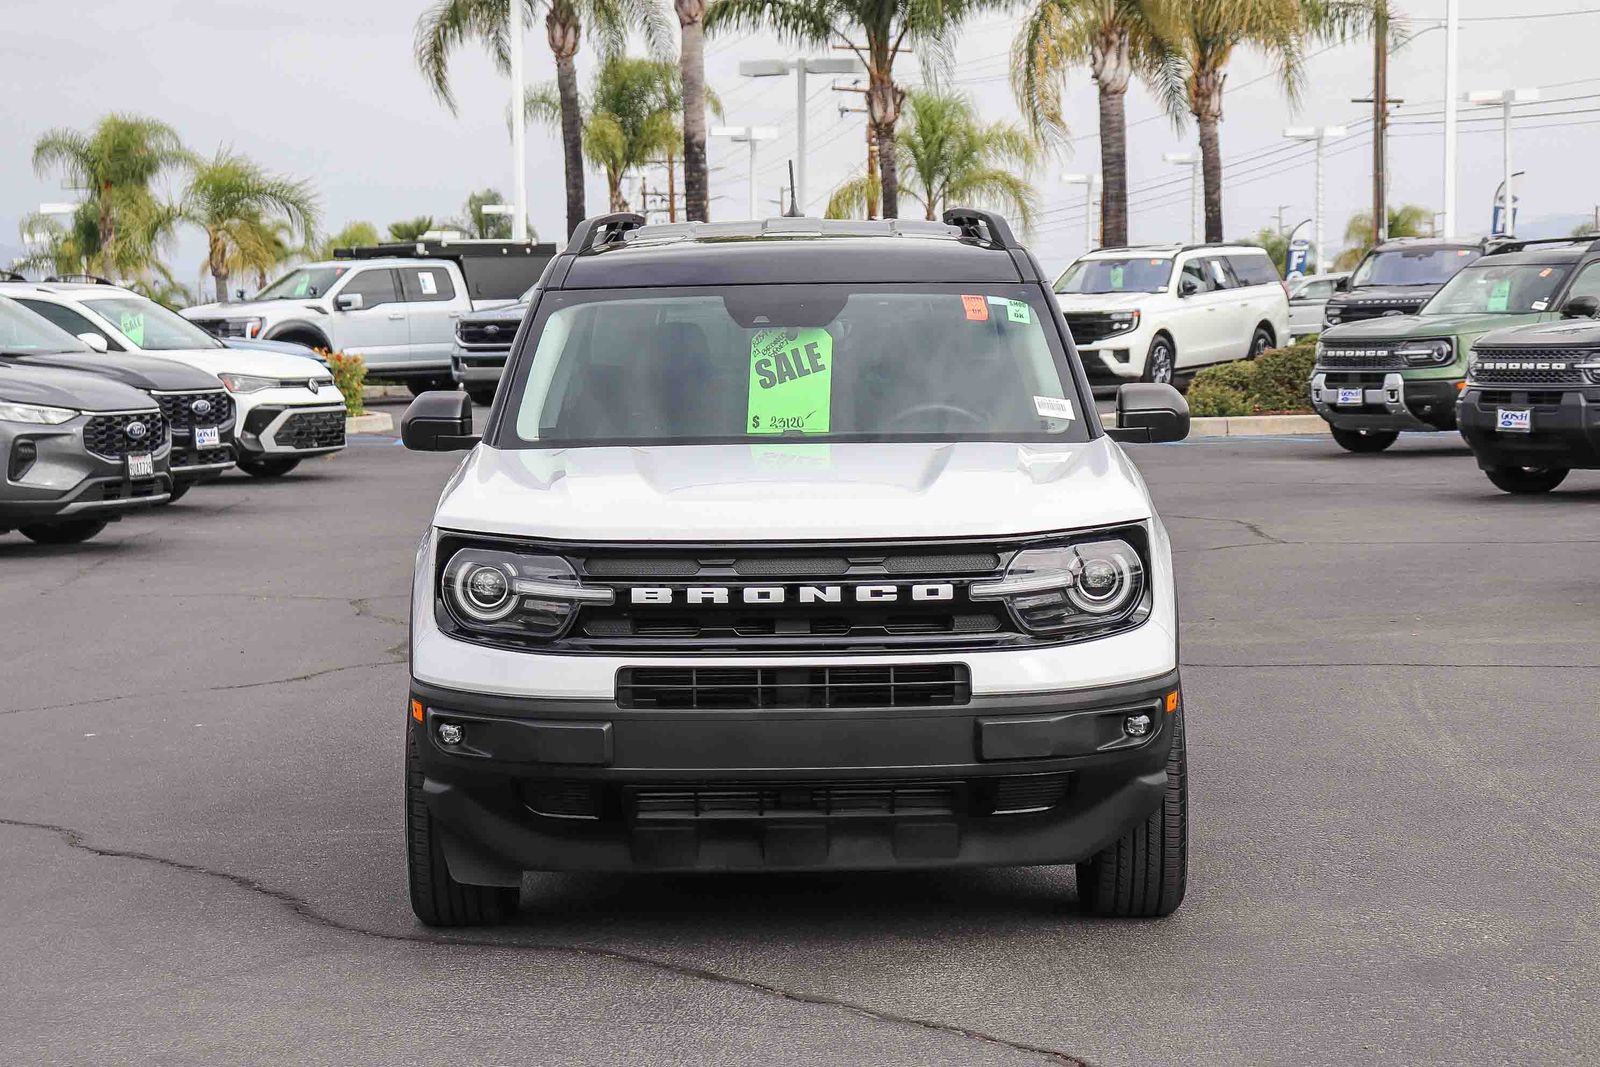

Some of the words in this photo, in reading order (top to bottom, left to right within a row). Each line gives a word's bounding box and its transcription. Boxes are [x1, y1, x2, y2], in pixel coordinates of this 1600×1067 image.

[754, 341, 826, 389] SALE
[1483, 362, 1566, 370] BRONCO
[752, 415, 760, 429] $
[769, 416, 804, 429] 23120
[631, 583, 954, 604] BRONCO
